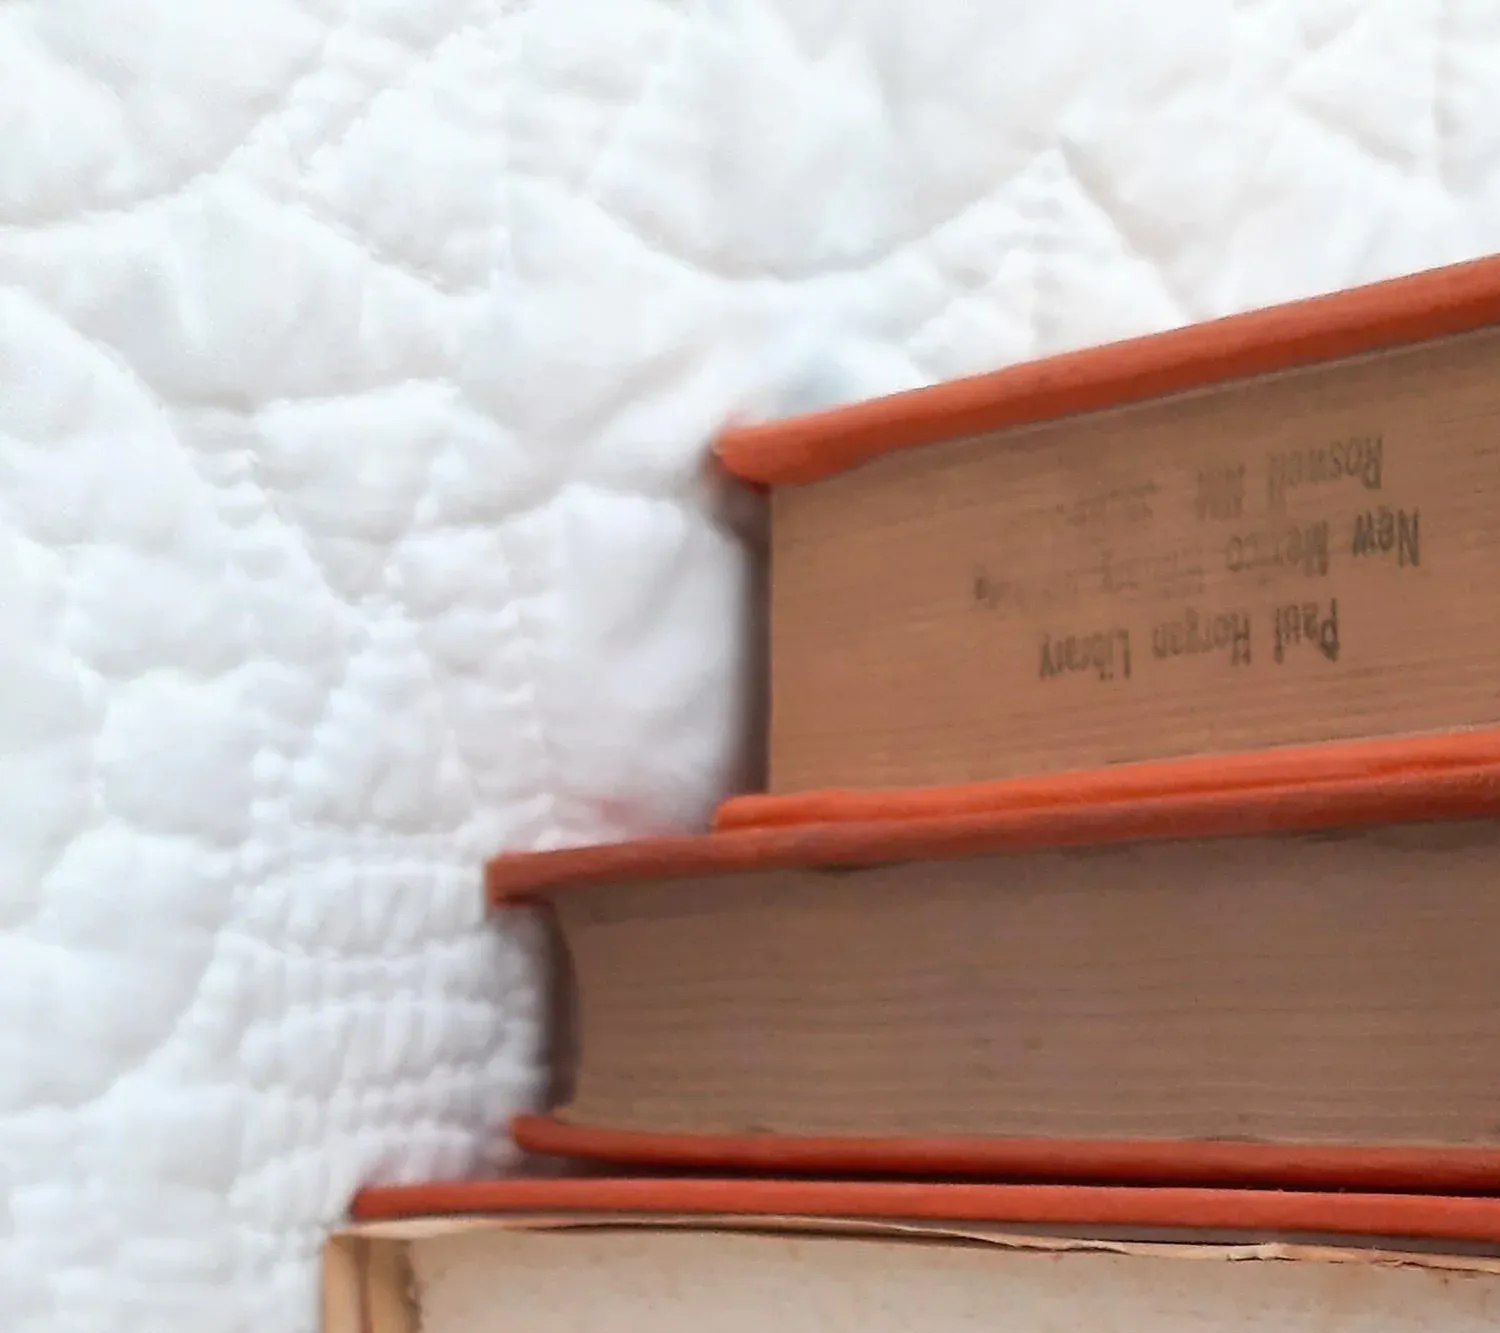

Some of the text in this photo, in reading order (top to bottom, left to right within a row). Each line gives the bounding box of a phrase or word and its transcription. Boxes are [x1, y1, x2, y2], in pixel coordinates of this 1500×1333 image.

[1226, 506, 1421, 577] New Meco
[1039, 628, 1132, 681] Library
[1274, 598, 1340, 663] Paul
